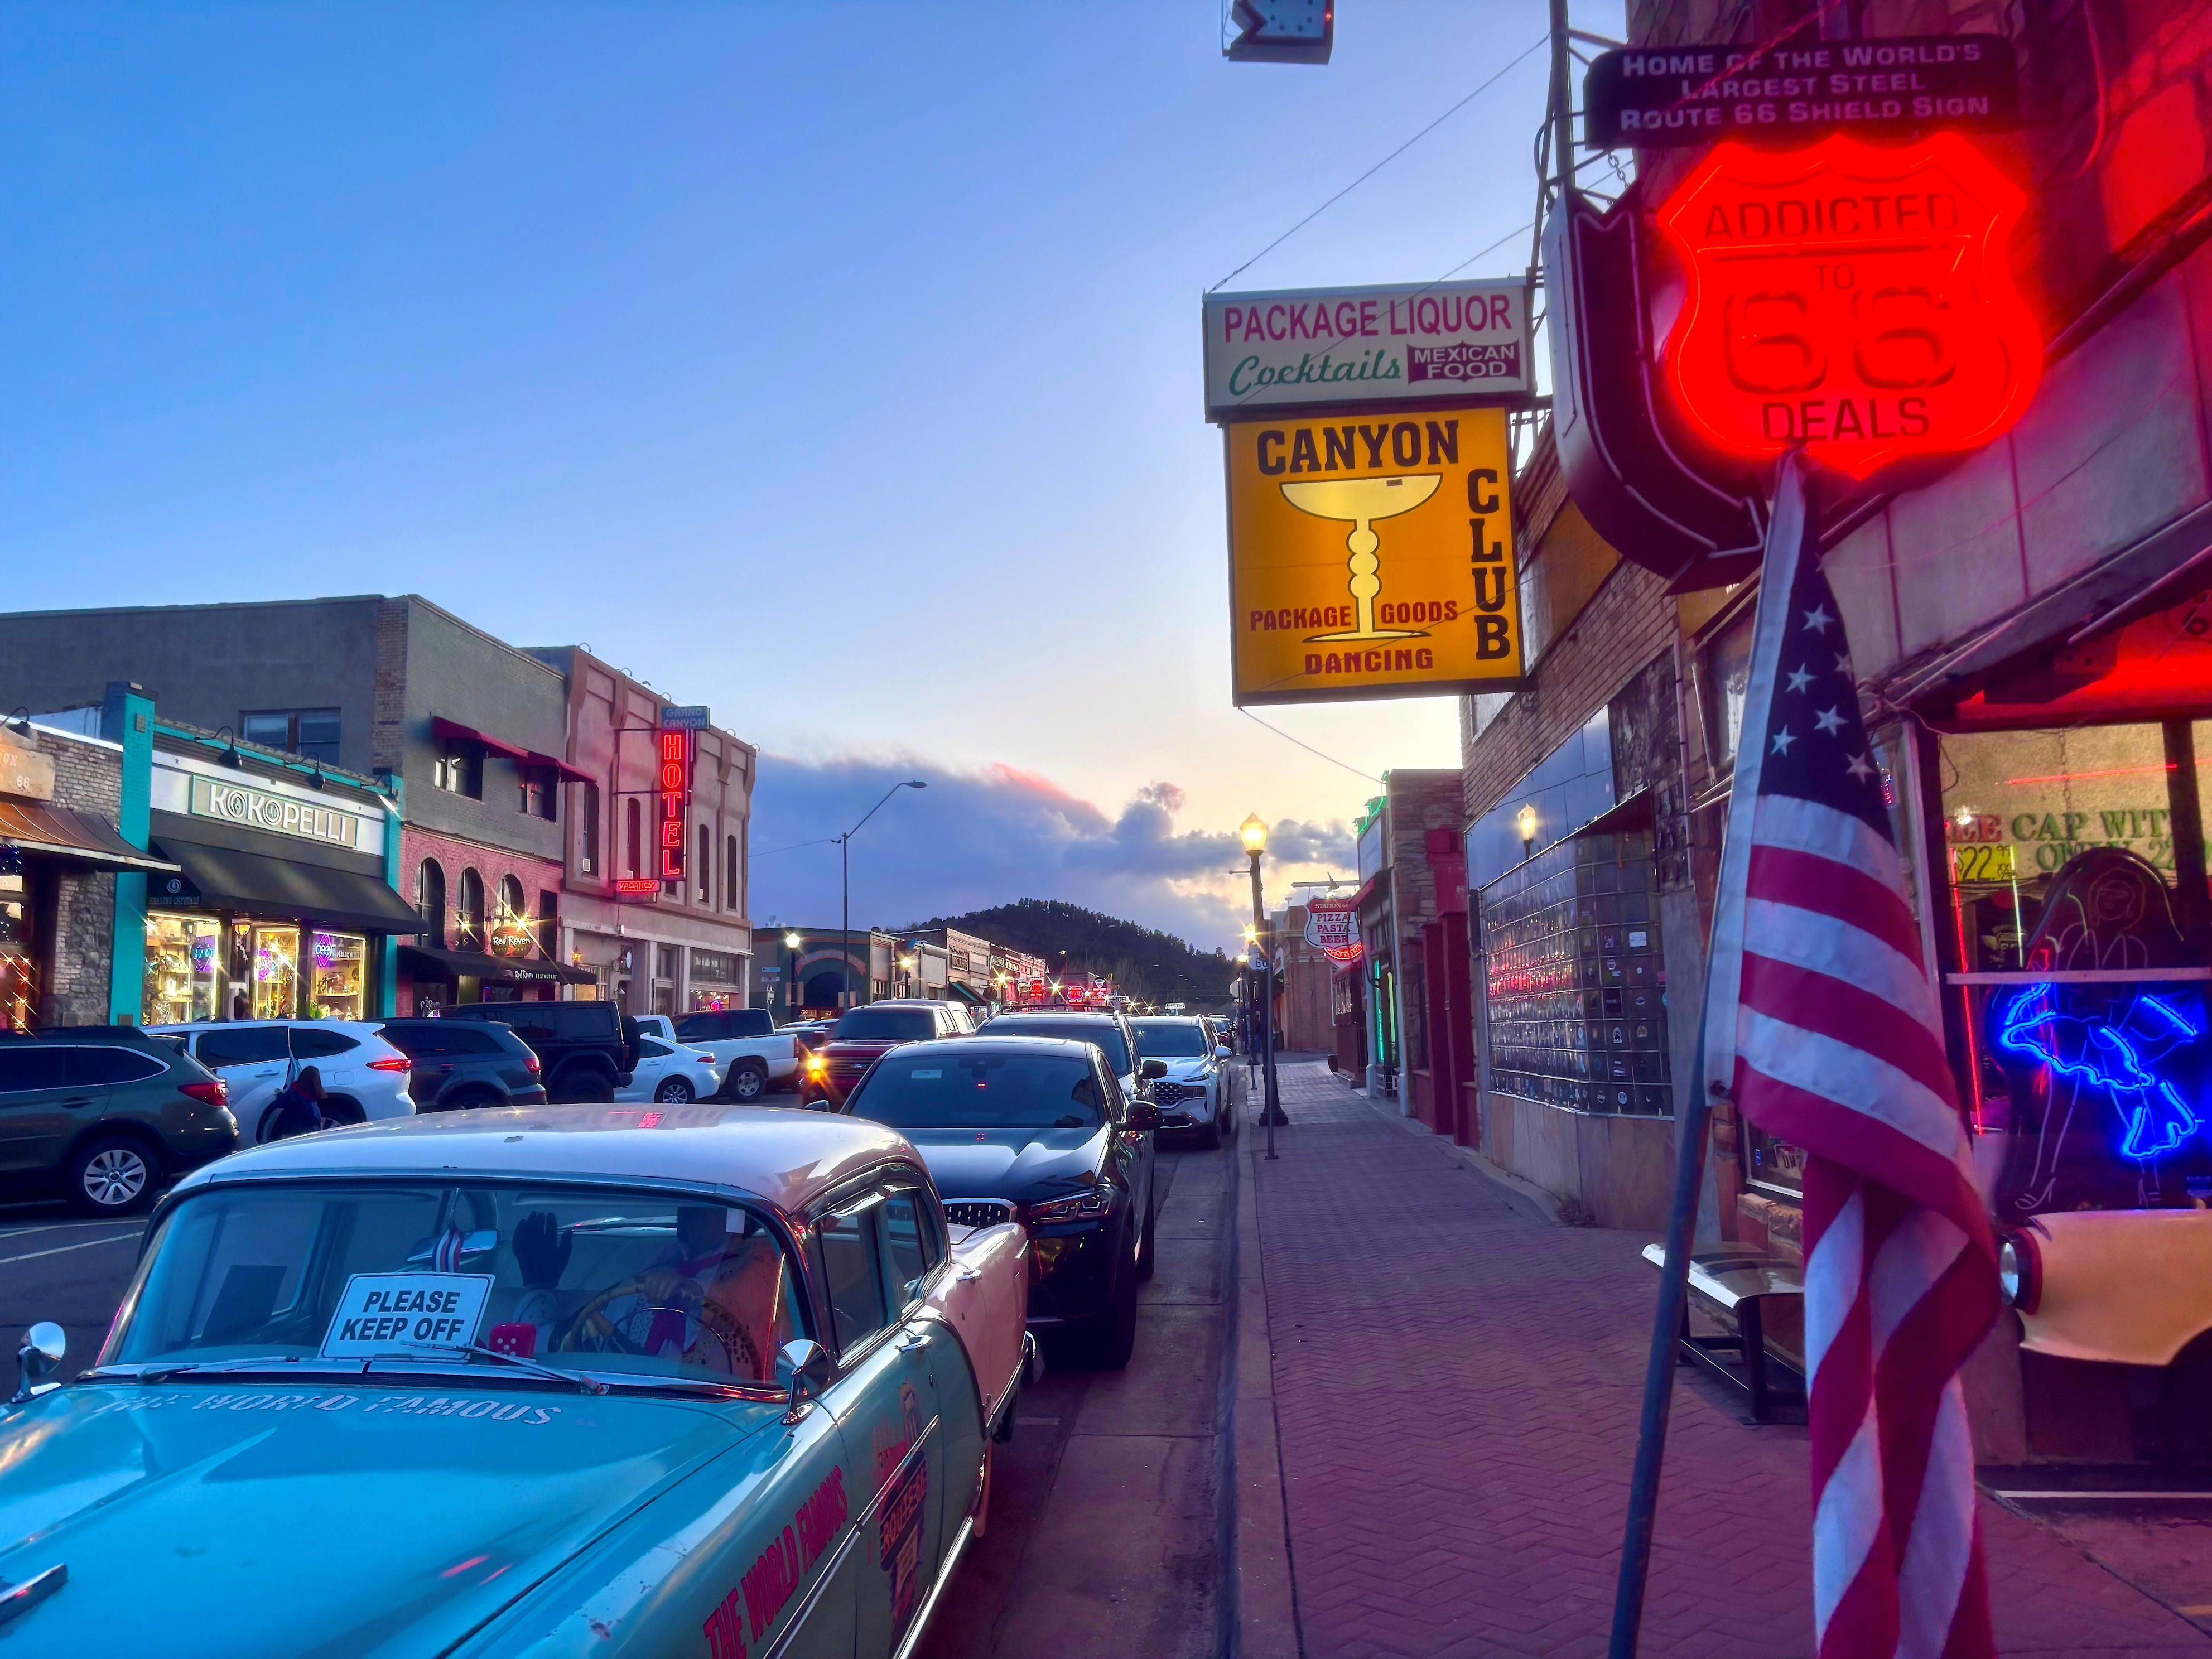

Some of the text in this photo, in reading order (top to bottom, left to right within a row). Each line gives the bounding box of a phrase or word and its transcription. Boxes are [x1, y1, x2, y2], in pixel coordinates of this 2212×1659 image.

[1623, 55, 1714, 77] HOME
[1774, 51, 1830, 70] THE
[1844, 44, 1982, 67] WORLD'S
[1681, 73, 1926, 99] LARGEST STEEL
[1620, 96, 1988, 131] ROUTE 66 SHIELD SIGN
[1705, 194, 1959, 240] ADDICTED
[1814, 264, 1854, 290] TO
[1225, 294, 1512, 343] PACKAGE LIQUOR
[1414, 345, 1515, 363] MEXICAN
[1724, 287, 1956, 394] 66
[1229, 349, 1400, 396] Cocktails
[1427, 361, 1507, 379] FOOD
[1762, 397, 1929, 442] DEALS
[1257, 419, 1459, 476] CANYON
[1467, 469, 1510, 660] CLUB
[1250, 600, 1458, 631] PACKAGE GOODS
[1305, 648, 1433, 675] DANCING
[663, 717, 705, 728] CANYON
[666, 707, 702, 717] GRAND
[17, 775, 30, 789] 66
[209, 784, 346, 842] KOKOPELLI
[662, 735, 682, 876] HOTEL
[1945, 811, 2172, 843] EE CAP WIT
[1317, 914, 1350, 922] PIZZA
[1317, 924, 1351, 933] PASTA
[492, 935, 531, 947] Red Raven
[1320, 935, 1349, 943] BEER
[514, 970, 523, 980] Red
[363, 1290, 461, 1314] PLEASE
[339, 1317, 465, 1342] KEEP OFF
[363, 1396, 562, 1425] FAMOUS
[703, 1465, 847, 1659] THE WORLD FAMOUS
